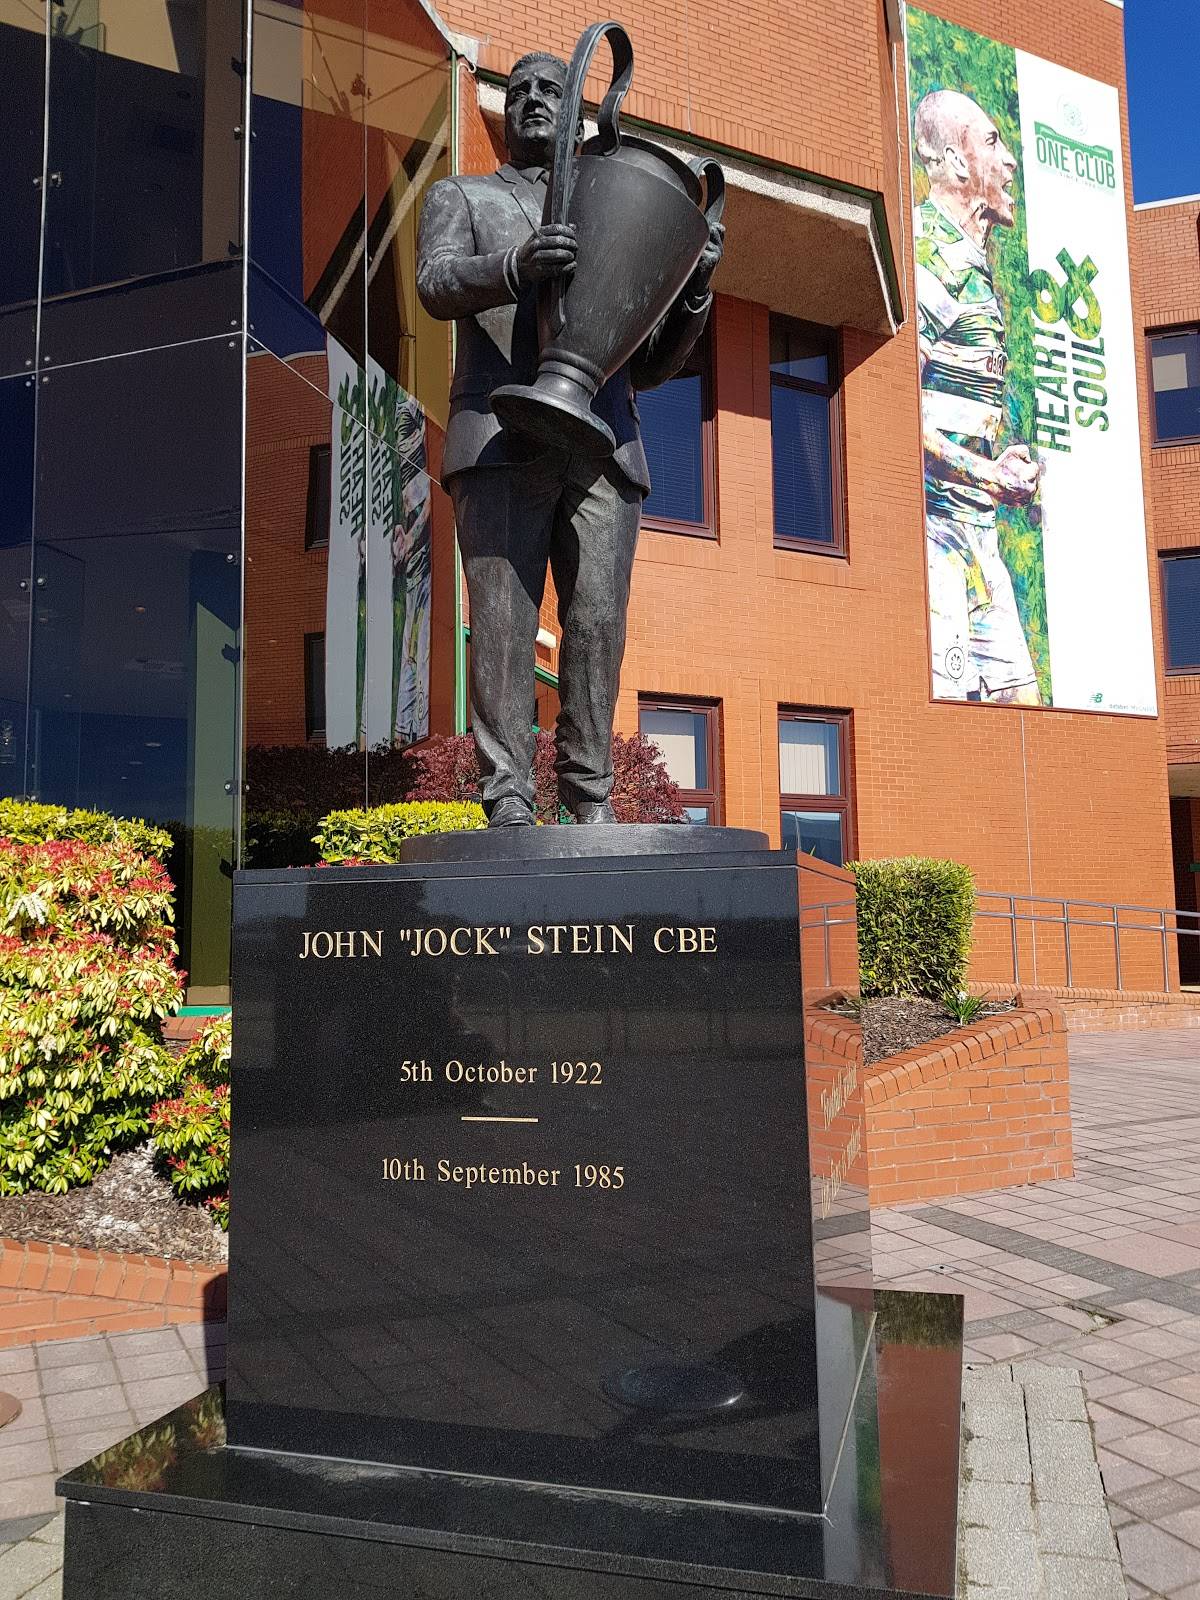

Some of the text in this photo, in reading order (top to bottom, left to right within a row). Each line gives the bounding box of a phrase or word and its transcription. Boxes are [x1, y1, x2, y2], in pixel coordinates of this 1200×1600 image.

[1036, 136, 1116, 189] ONE CLUB
[1028, 247, 1102, 454] HEART &
[1071, 337, 1110, 432] SOUL
[299, 924, 718, 959] JOHN "JOCK" STEIN CBE
[400, 1060, 603, 1085] 5th October 1922
[381, 1158, 625, 1189] 10th September 1985
